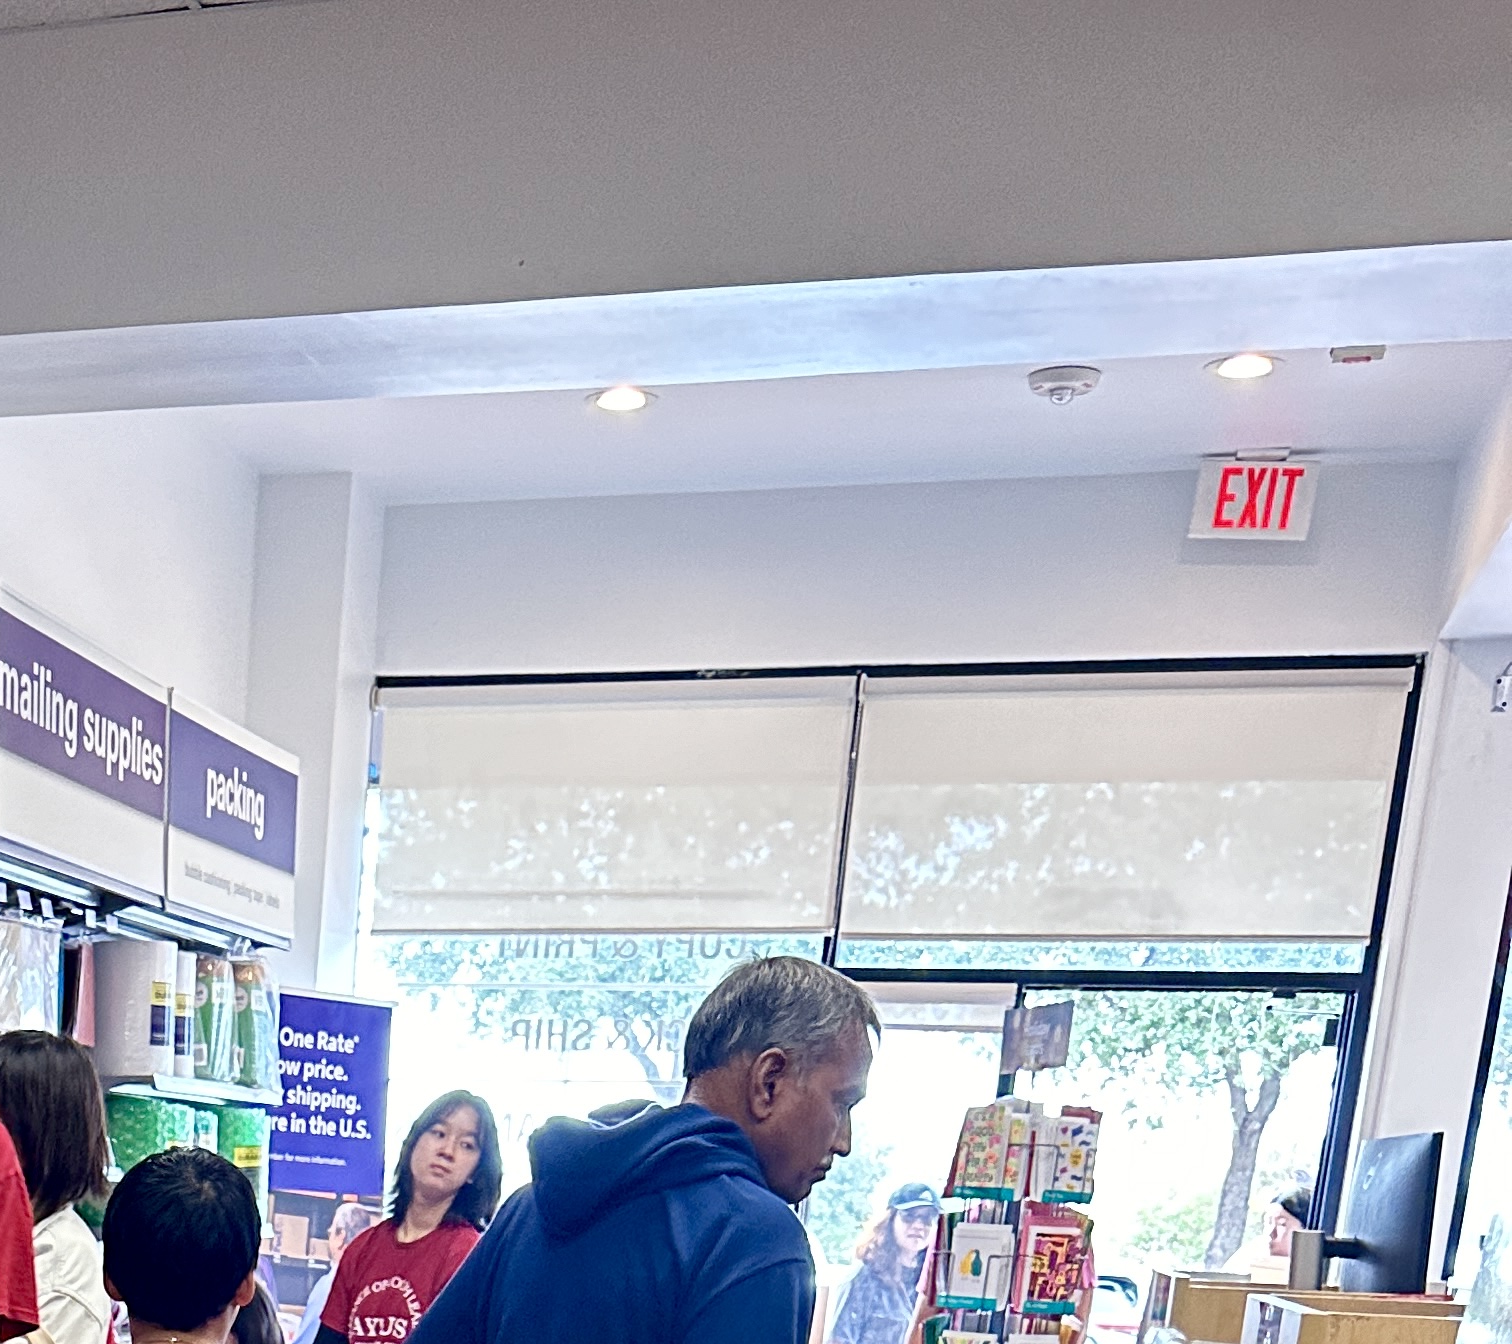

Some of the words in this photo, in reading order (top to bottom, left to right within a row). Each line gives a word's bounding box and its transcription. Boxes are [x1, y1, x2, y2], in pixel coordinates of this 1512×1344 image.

[1211, 467, 1305, 531] EXIT
[83, 707, 164, 785] supplies
[206, 766, 265, 841] packing
[280, 1026, 314, 1050] One
[276, 1059, 302, 1077] ow
[303, 1058, 349, 1082] price.
[286, 1085, 362, 1116] shipping.
[290, 1111, 306, 1134] in
[309, 1115, 337, 1137] the
[339, 1118, 372, 1140] U.S.
